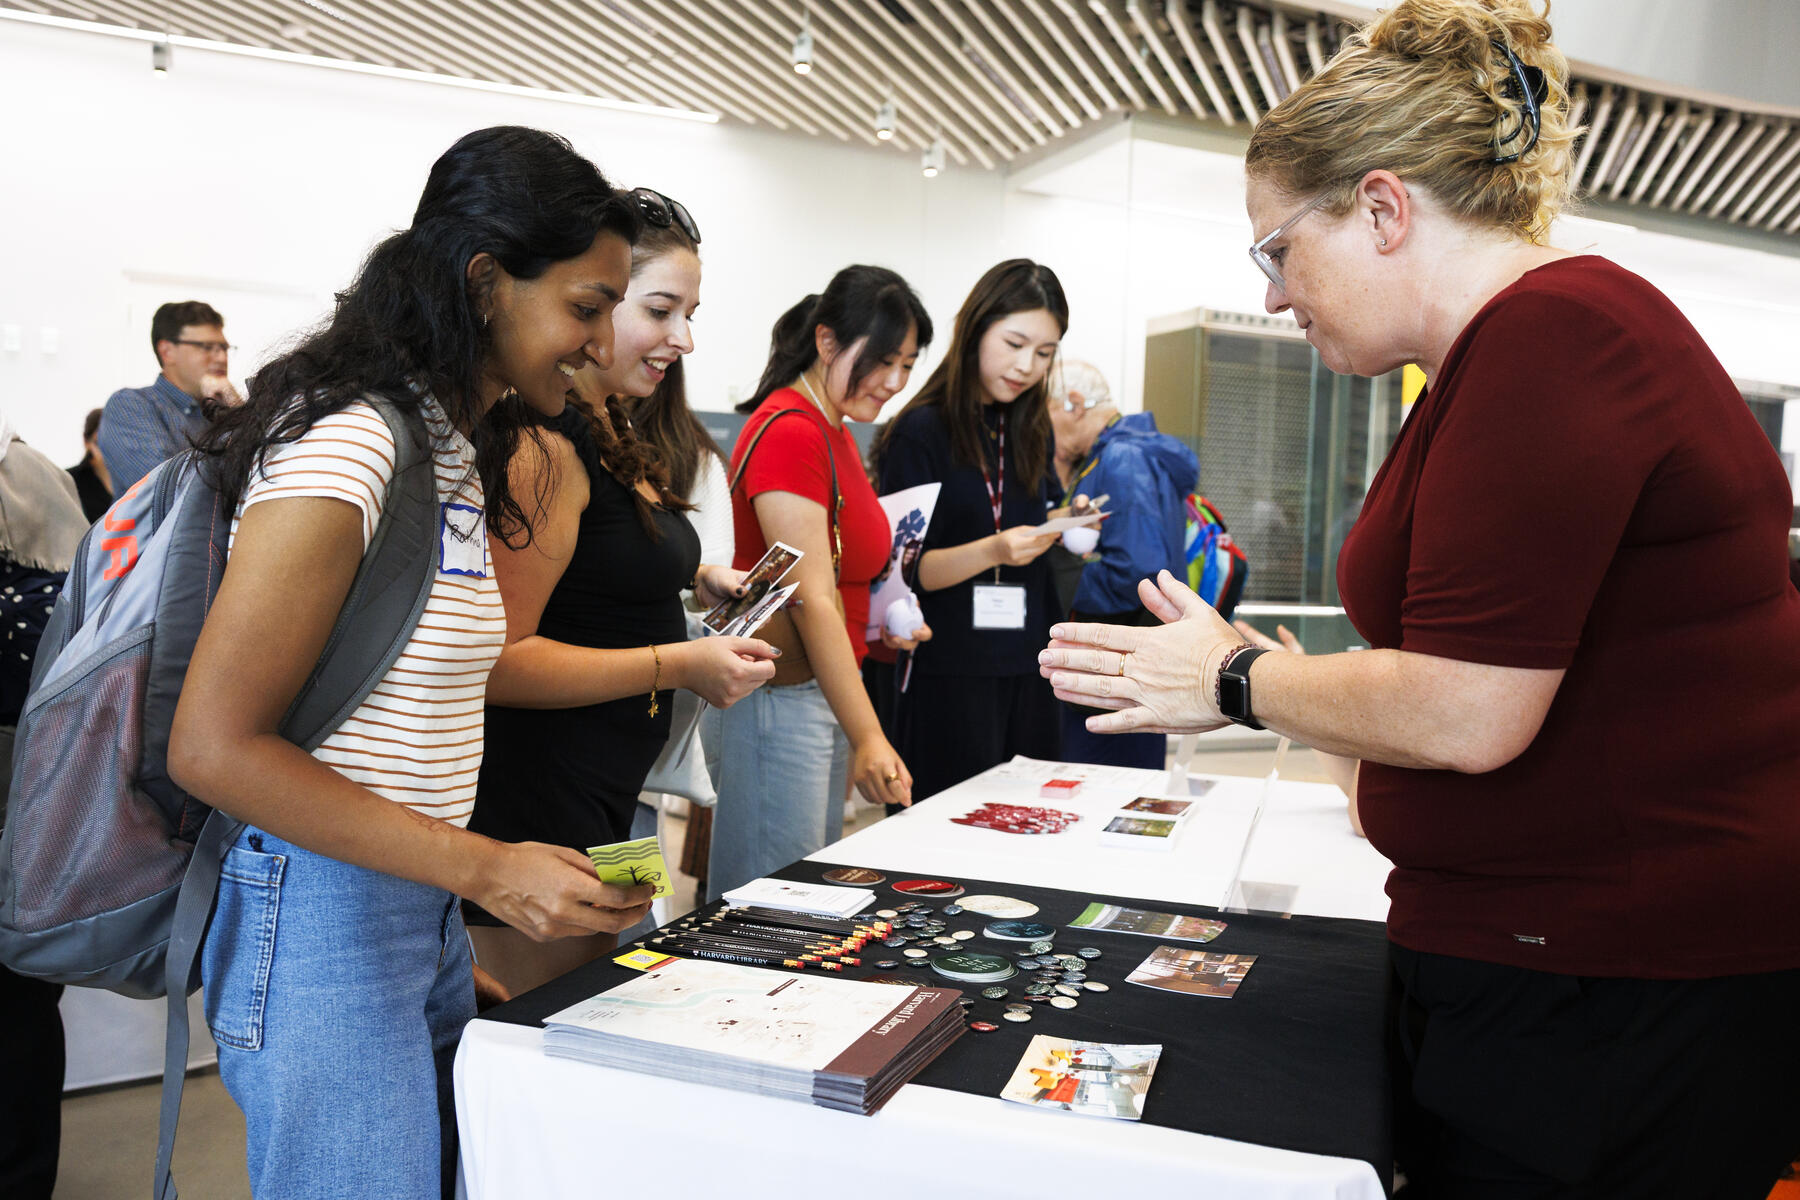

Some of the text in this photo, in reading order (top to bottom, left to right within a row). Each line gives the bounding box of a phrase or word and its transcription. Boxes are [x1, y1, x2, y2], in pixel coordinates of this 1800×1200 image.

[700, 951, 768, 965] HARVARD LIBRARY
[898, 991, 935, 1015] Harvard
[872, 1014, 911, 1036] Library
